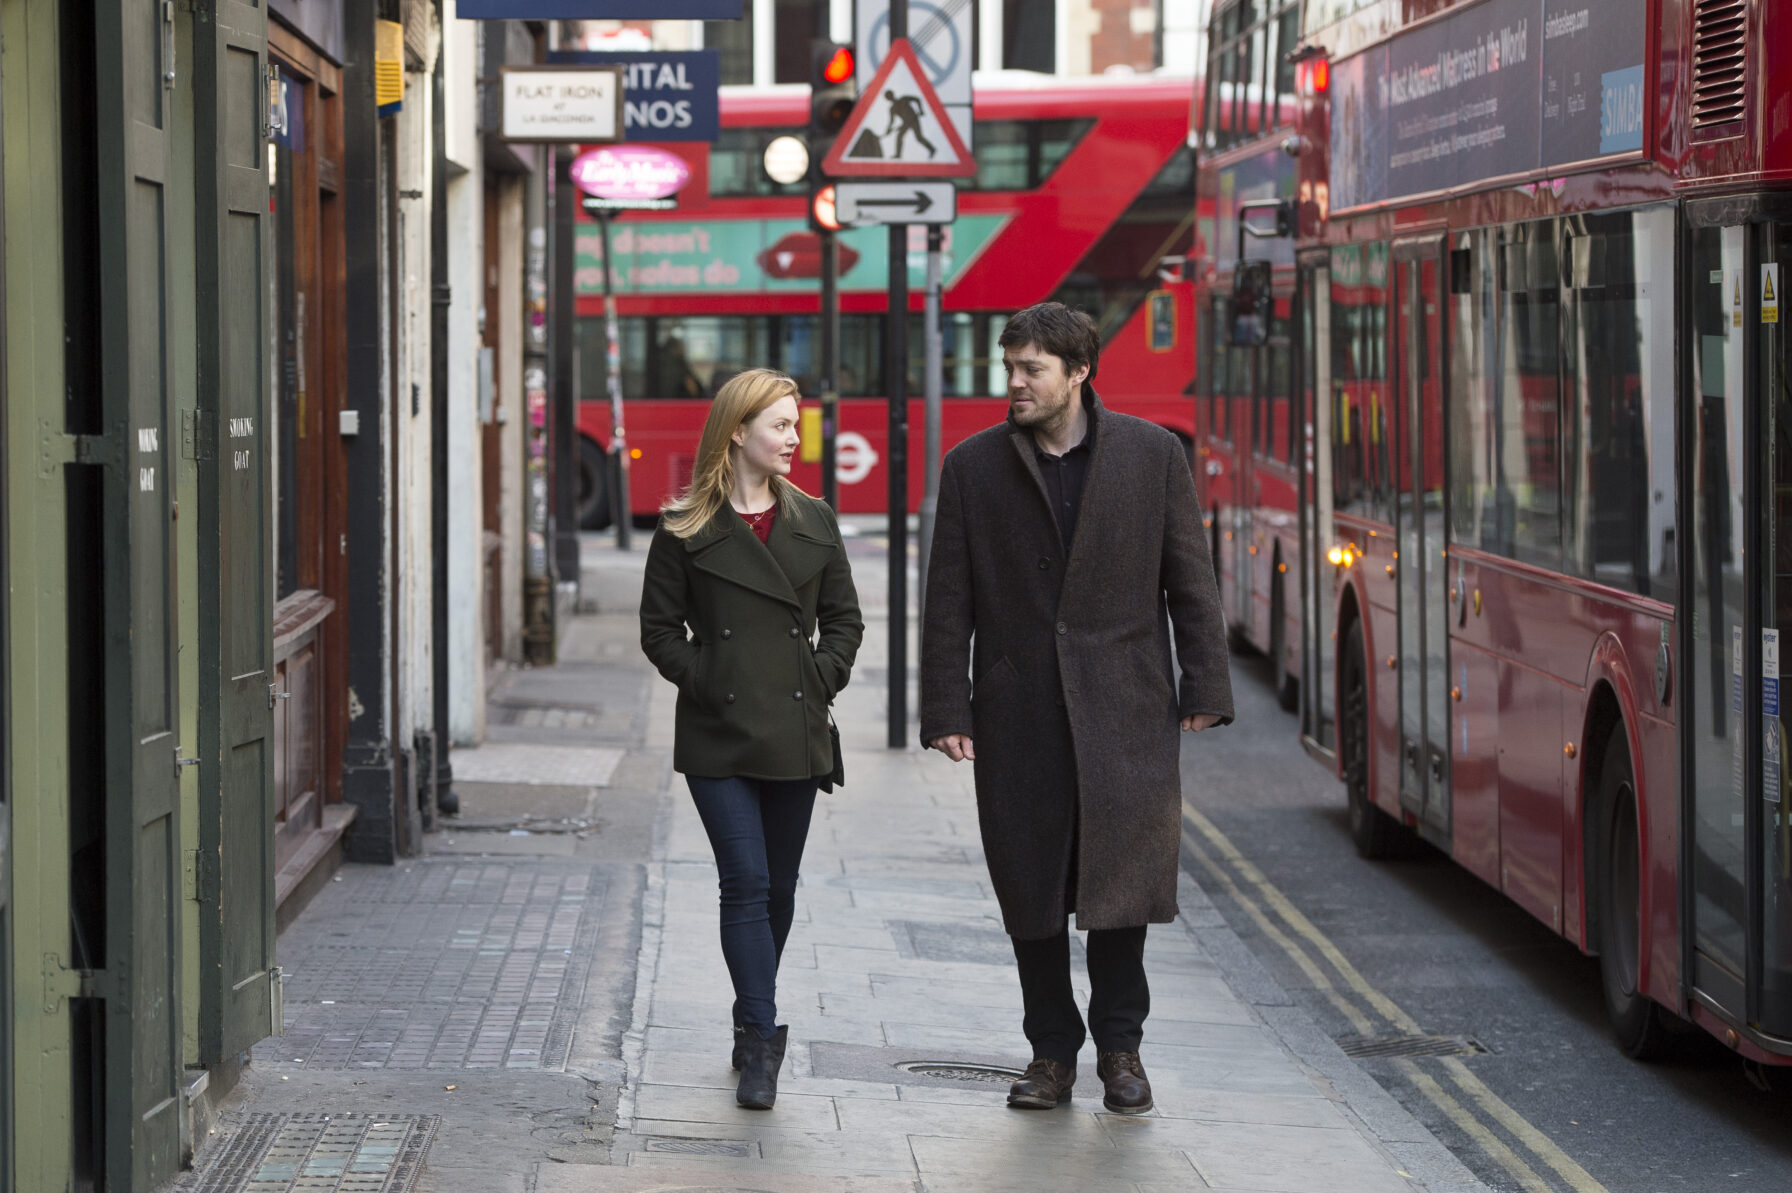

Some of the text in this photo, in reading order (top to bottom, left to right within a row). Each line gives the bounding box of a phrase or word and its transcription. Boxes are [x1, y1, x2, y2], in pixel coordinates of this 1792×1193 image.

[1477, 35, 1486, 76] in
[1501, 17, 1527, 68] World
[622, 63, 694, 90] ITAL
[516, 85, 603, 98] FLAT IRON
[703, 258, 740, 285] do
[230, 417, 253, 438] SMOKING
[234, 450, 249, 471] GOAT
